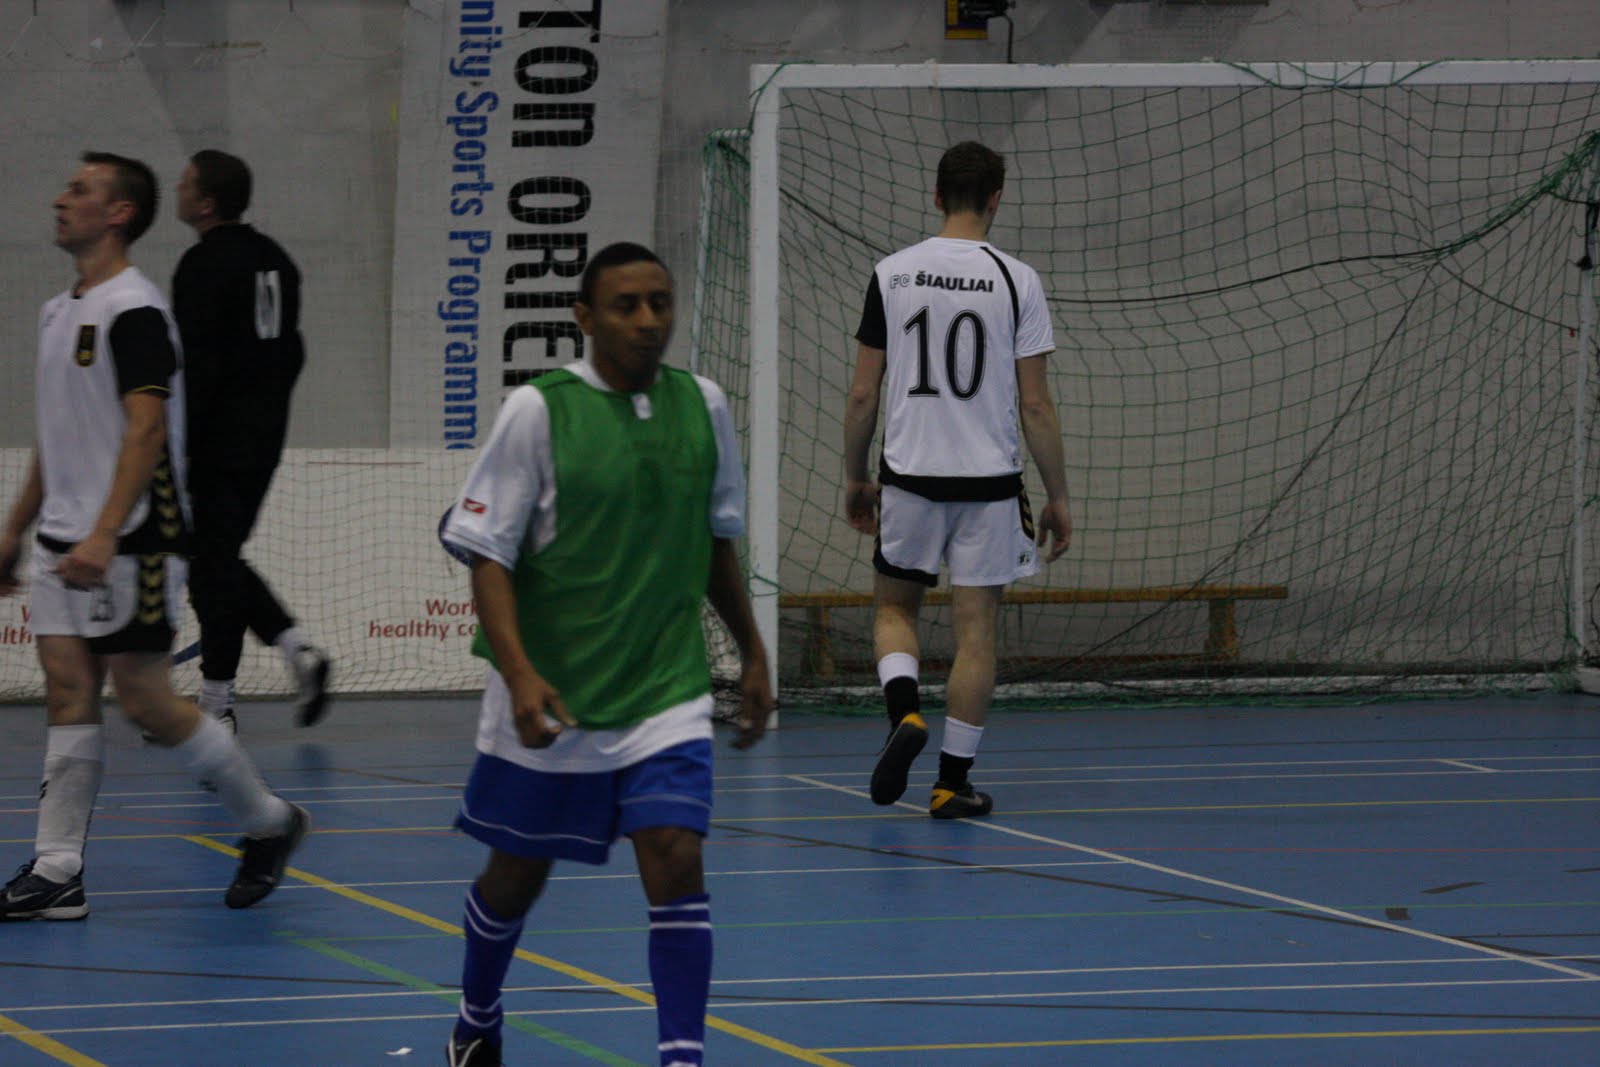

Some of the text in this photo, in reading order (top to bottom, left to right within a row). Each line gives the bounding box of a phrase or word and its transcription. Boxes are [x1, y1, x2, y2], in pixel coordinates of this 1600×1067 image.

[446, 90, 500, 217] Sports
[889, 271, 994, 292] FC ŠIAULIAI
[903, 305, 987, 401] 10
[369, 620, 449, 641] healthy
